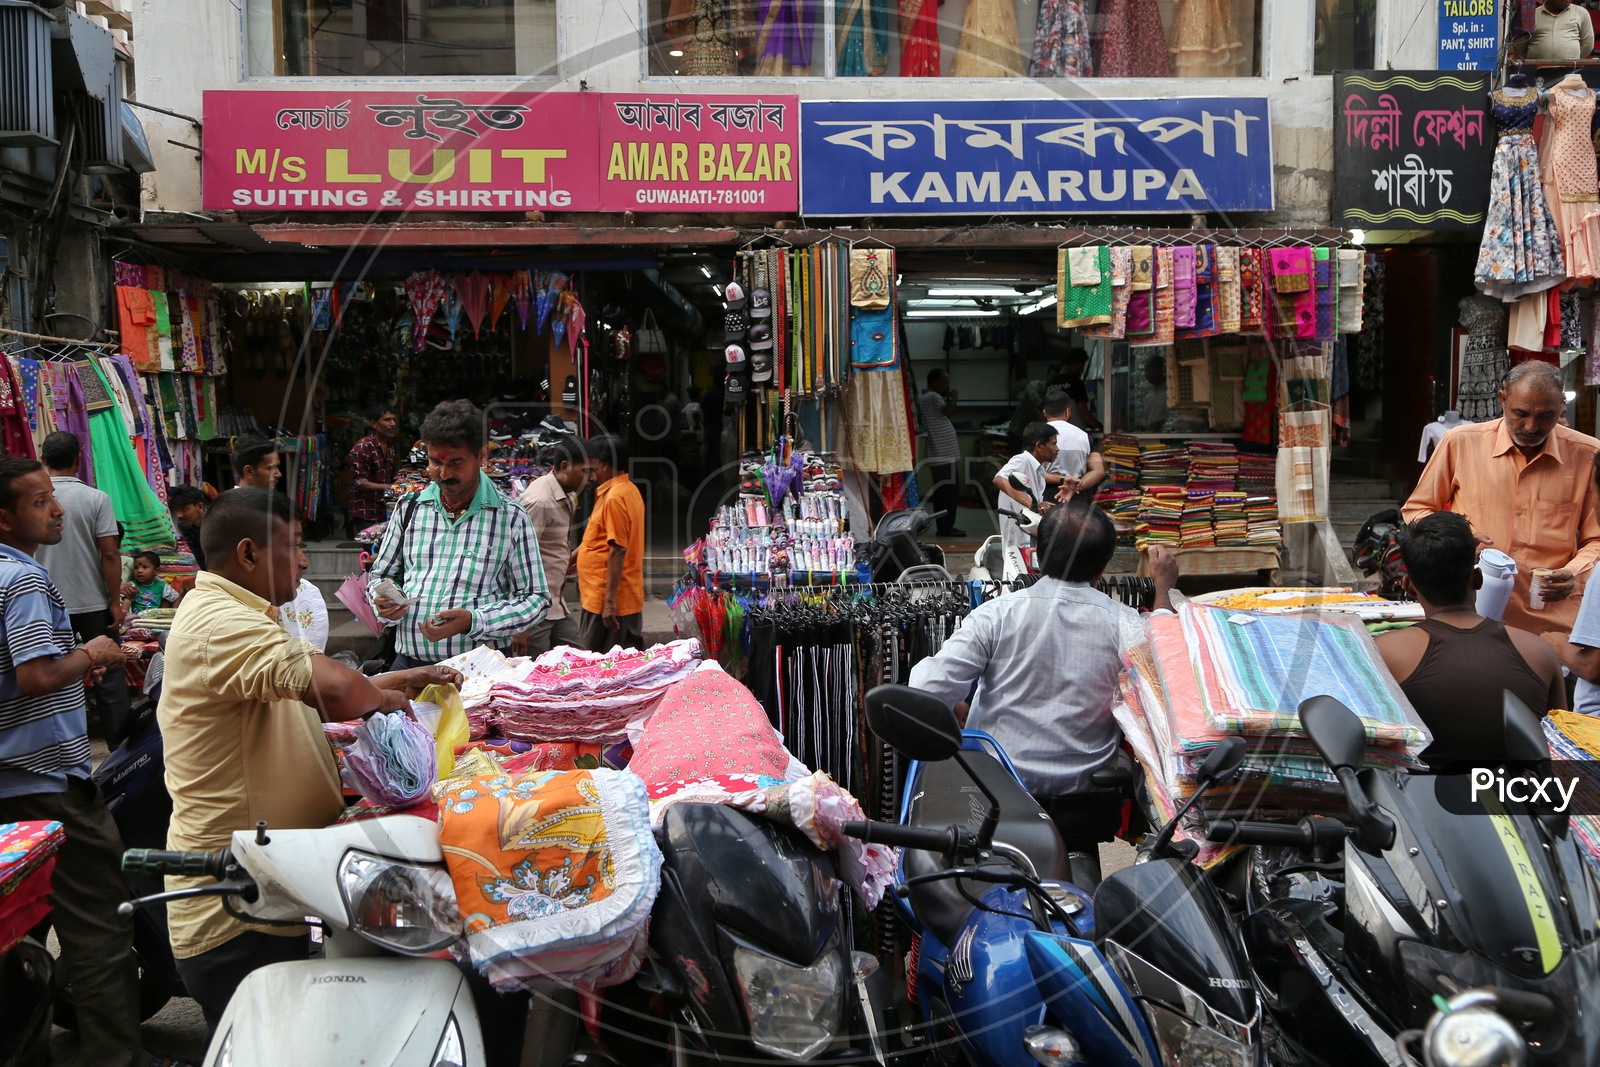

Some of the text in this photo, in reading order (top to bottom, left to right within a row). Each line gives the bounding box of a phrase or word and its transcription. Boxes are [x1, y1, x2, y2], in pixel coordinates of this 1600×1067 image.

[1443, 0, 1494, 17] TAILORS
[1452, 22, 1469, 36] Spl.
[1470, 21, 1479, 33] in
[1441, 37, 1495, 52] PANT, SHIRT
[1464, 52, 1470, 61] &
[235, 148, 567, 184] M/S LUIT
[606, 141, 793, 182] AMAR BAZAR
[869, 169, 1209, 204] KAMARUPA
[232, 189, 572, 207] SUITING & SHIRTING
[635, 189, 765, 204] GUWAHATI-781001
[113, 753, 148, 785] MAESTRO
[311, 975, 367, 985] HONDA
